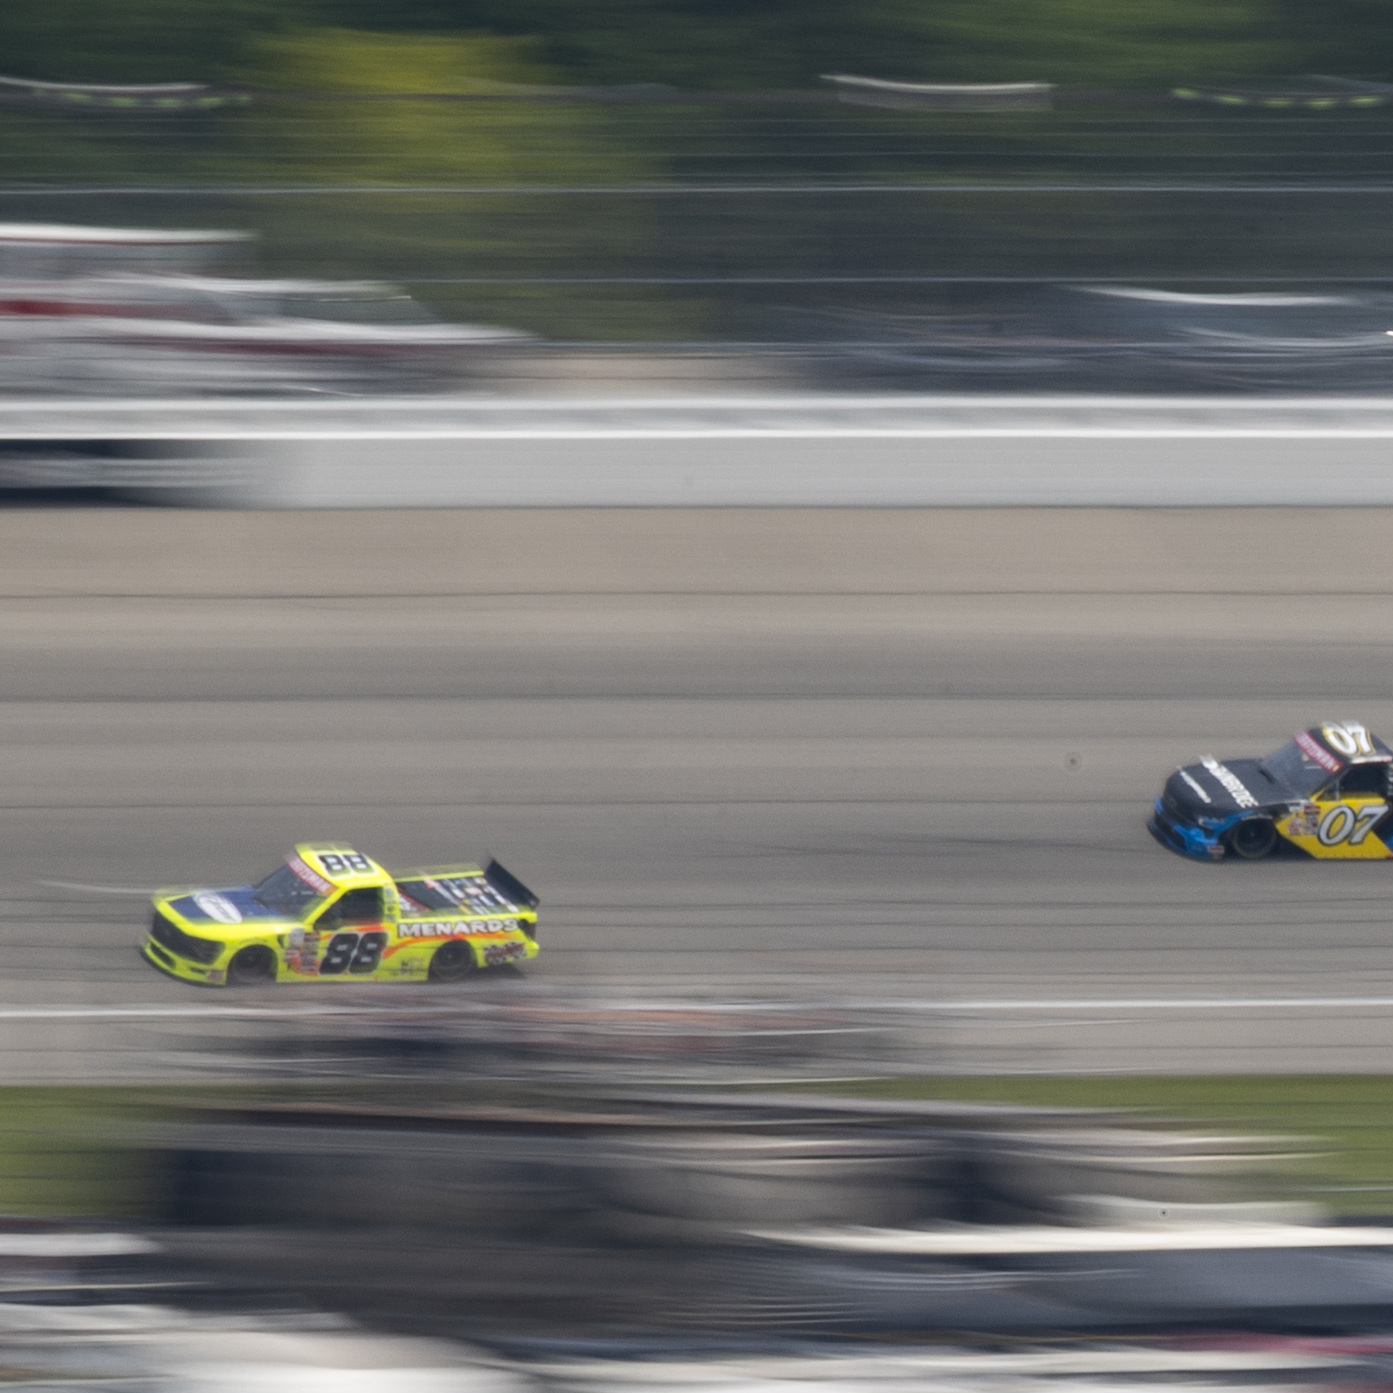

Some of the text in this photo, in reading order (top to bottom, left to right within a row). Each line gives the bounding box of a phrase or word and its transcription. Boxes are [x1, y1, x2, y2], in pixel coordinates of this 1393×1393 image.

[1323, 722, 1375, 757] 07
[1318, 804, 1390, 846] 07
[316, 852, 379, 879] 88
[398, 918, 520, 938] MENARDS
[319, 931, 390, 975] 88
